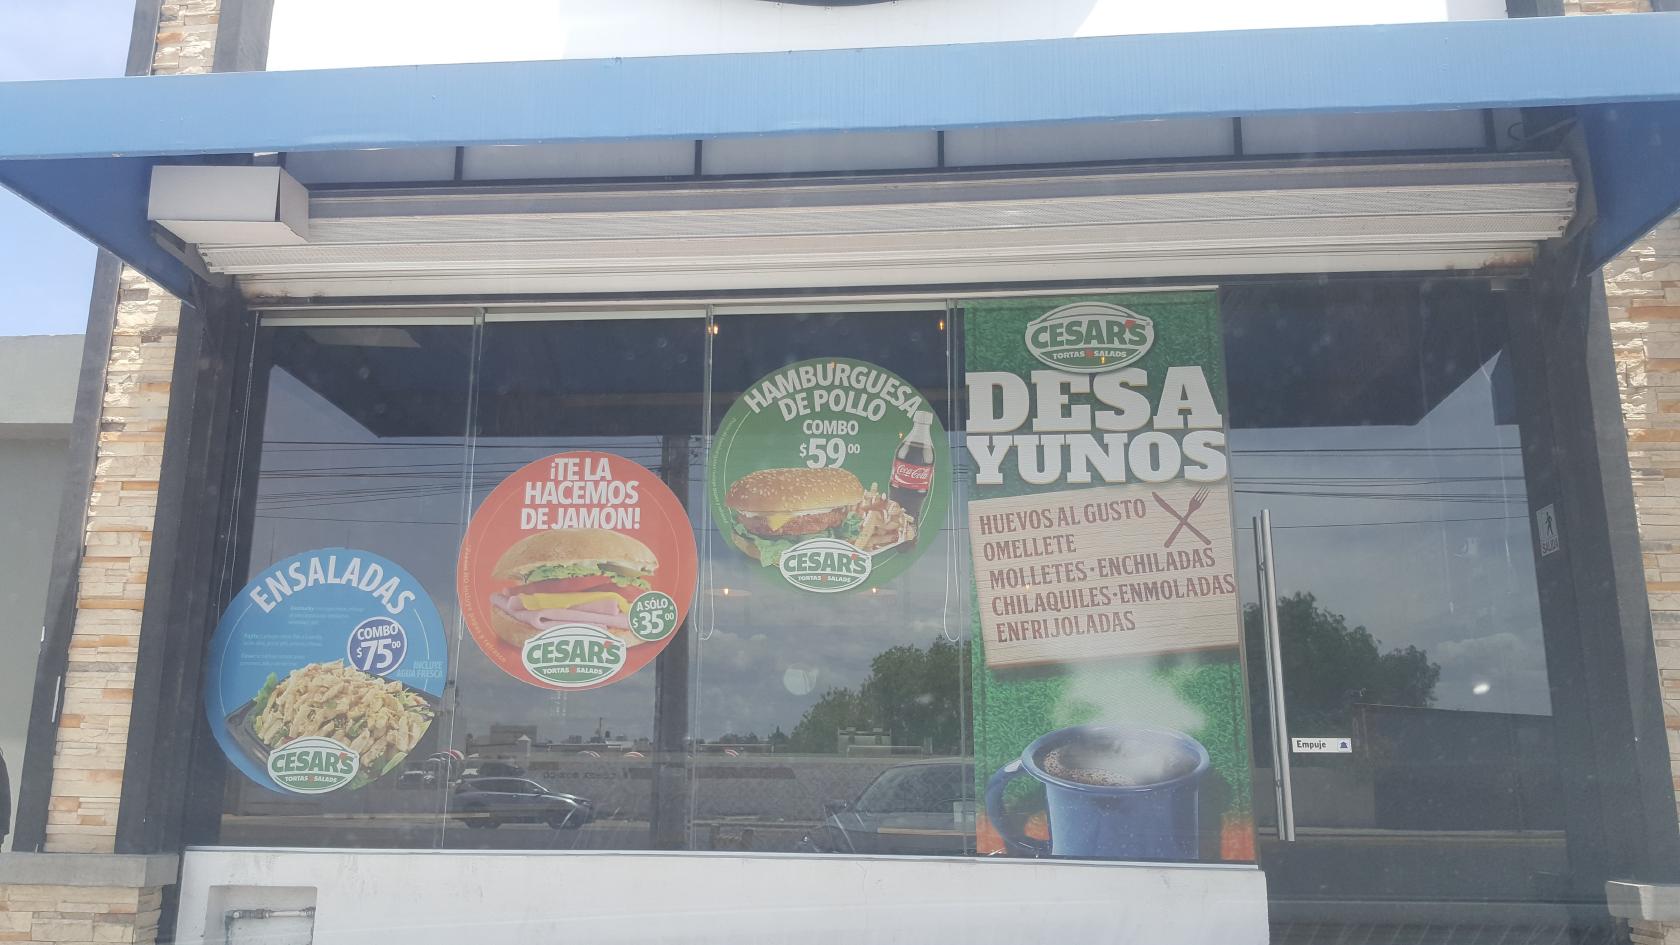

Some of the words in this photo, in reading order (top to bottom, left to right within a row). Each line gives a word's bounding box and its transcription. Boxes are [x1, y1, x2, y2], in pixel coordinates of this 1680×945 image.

[1031, 320, 1148, 346] CESAR'S
[1052, 351, 1085, 359] TORTAS
[1093, 350, 1127, 358] SALADS
[744, 363, 922, 418] HAMBURGUESA
[965, 366, 1223, 433] DESA
[778, 393, 811, 421] DE
[813, 389, 886, 421] POLLO
[803, 420, 859, 435] COMBO
[584, 458, 612, 480] LA
[966, 430, 1227, 485] YUNOS
[524, 480, 640, 505] HACEMOS
[520, 508, 549, 530] DE
[551, 503, 641, 530] JAMÓN!
[979, 508, 1054, 535] HUEVOS
[1057, 506, 1081, 528] AL
[1083, 498, 1146, 524] GUSTO
[983, 533, 1077, 561] OMELLETE
[783, 552, 867, 574] CESAR'S
[989, 561, 1088, 590] MOLLETES
[1096, 547, 1216, 578] ENCHILADAS
[250, 555, 416, 615] ENSALADAS
[991, 586, 1112, 616] CHILAQUILES
[1119, 573, 1236, 604] ENMOLADAS
[636, 601, 644, 611] A
[357, 624, 399, 641] COMBO
[996, 611, 1136, 643] ENFRIJOLADAS
[526, 640, 621, 665] CESAR'S
[542, 667, 570, 675] TORTAS
[576, 667, 603, 675] SALADS
[1296, 740, 1327, 749] Empuje
[271, 750, 356, 774] CESAR'S
[285, 775, 309, 783] TORTAS
[314, 775, 338, 784] SALADS
